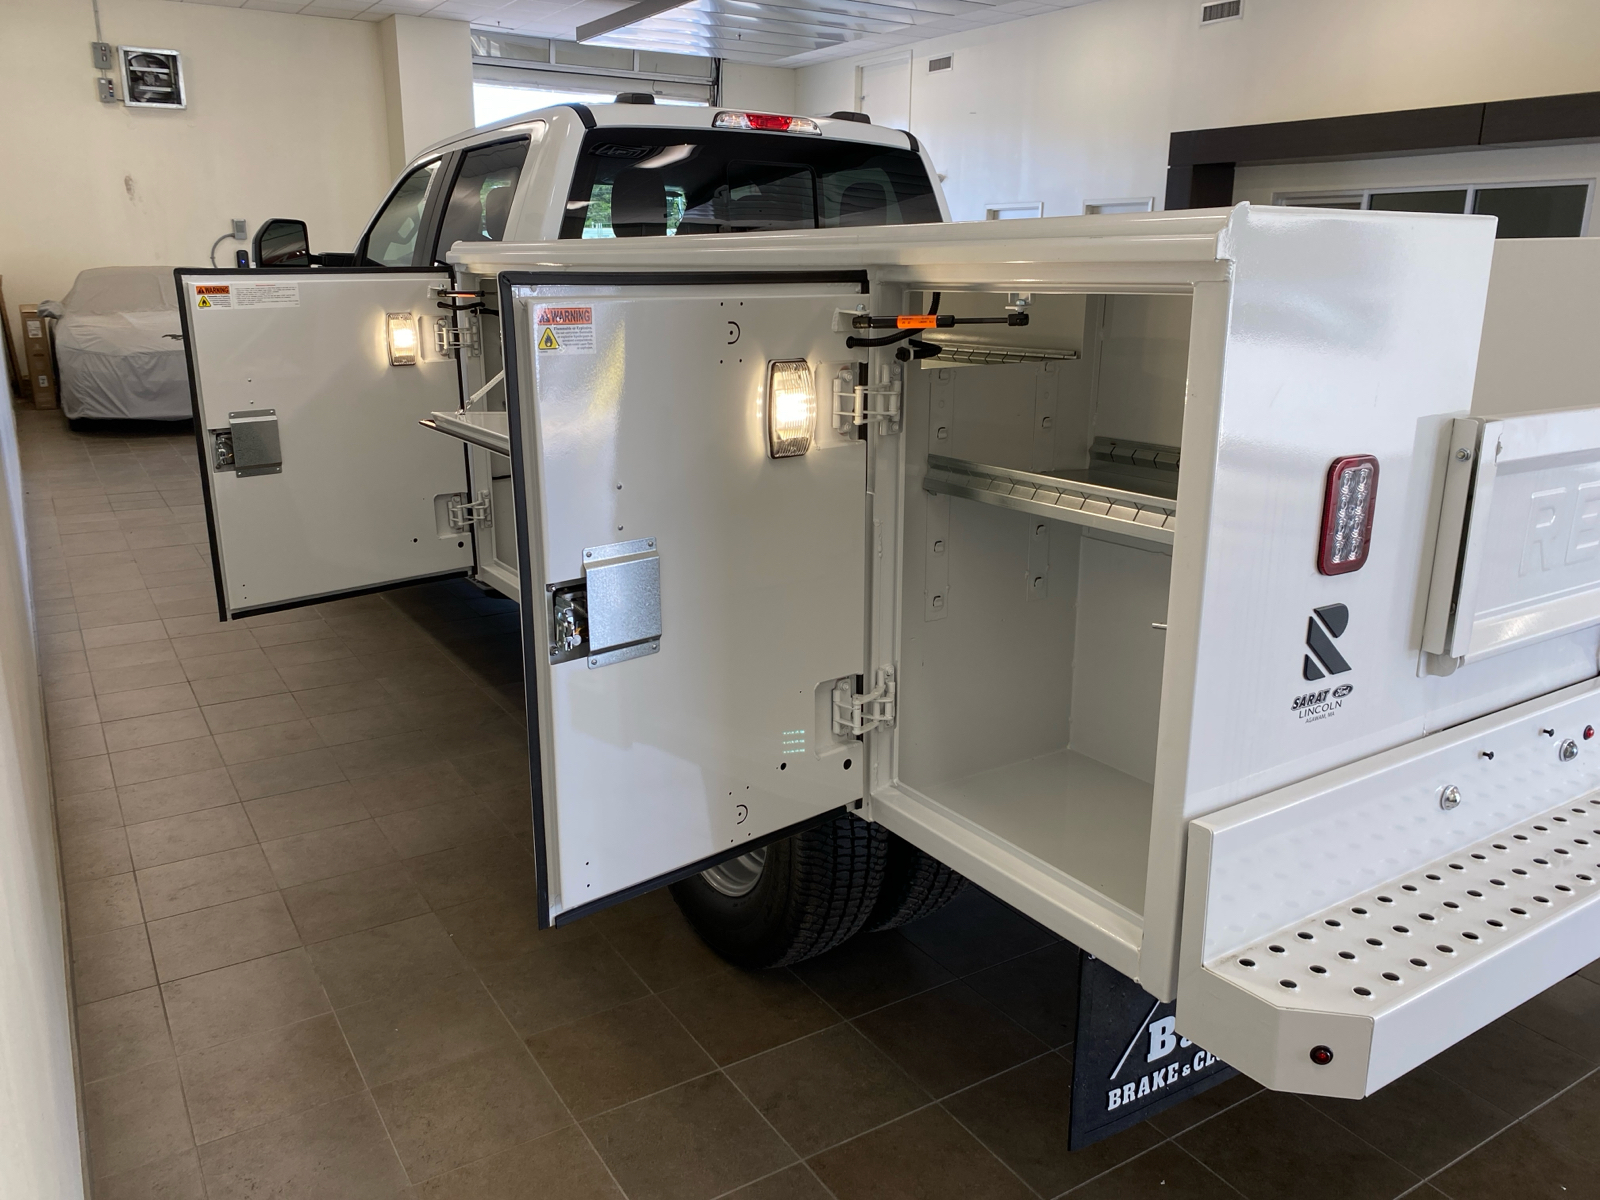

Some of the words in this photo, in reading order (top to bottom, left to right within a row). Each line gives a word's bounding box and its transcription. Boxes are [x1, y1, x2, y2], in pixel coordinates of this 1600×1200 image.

[205, 286, 229, 294] WARNING
[551, 310, 590, 322] WARNING
[1291, 688, 1331, 711] SARAT
[1299, 700, 1342, 719] LINCOLN
[1107, 1062, 1179, 1111] BRAKE
[1182, 1064, 1191, 1077] &
